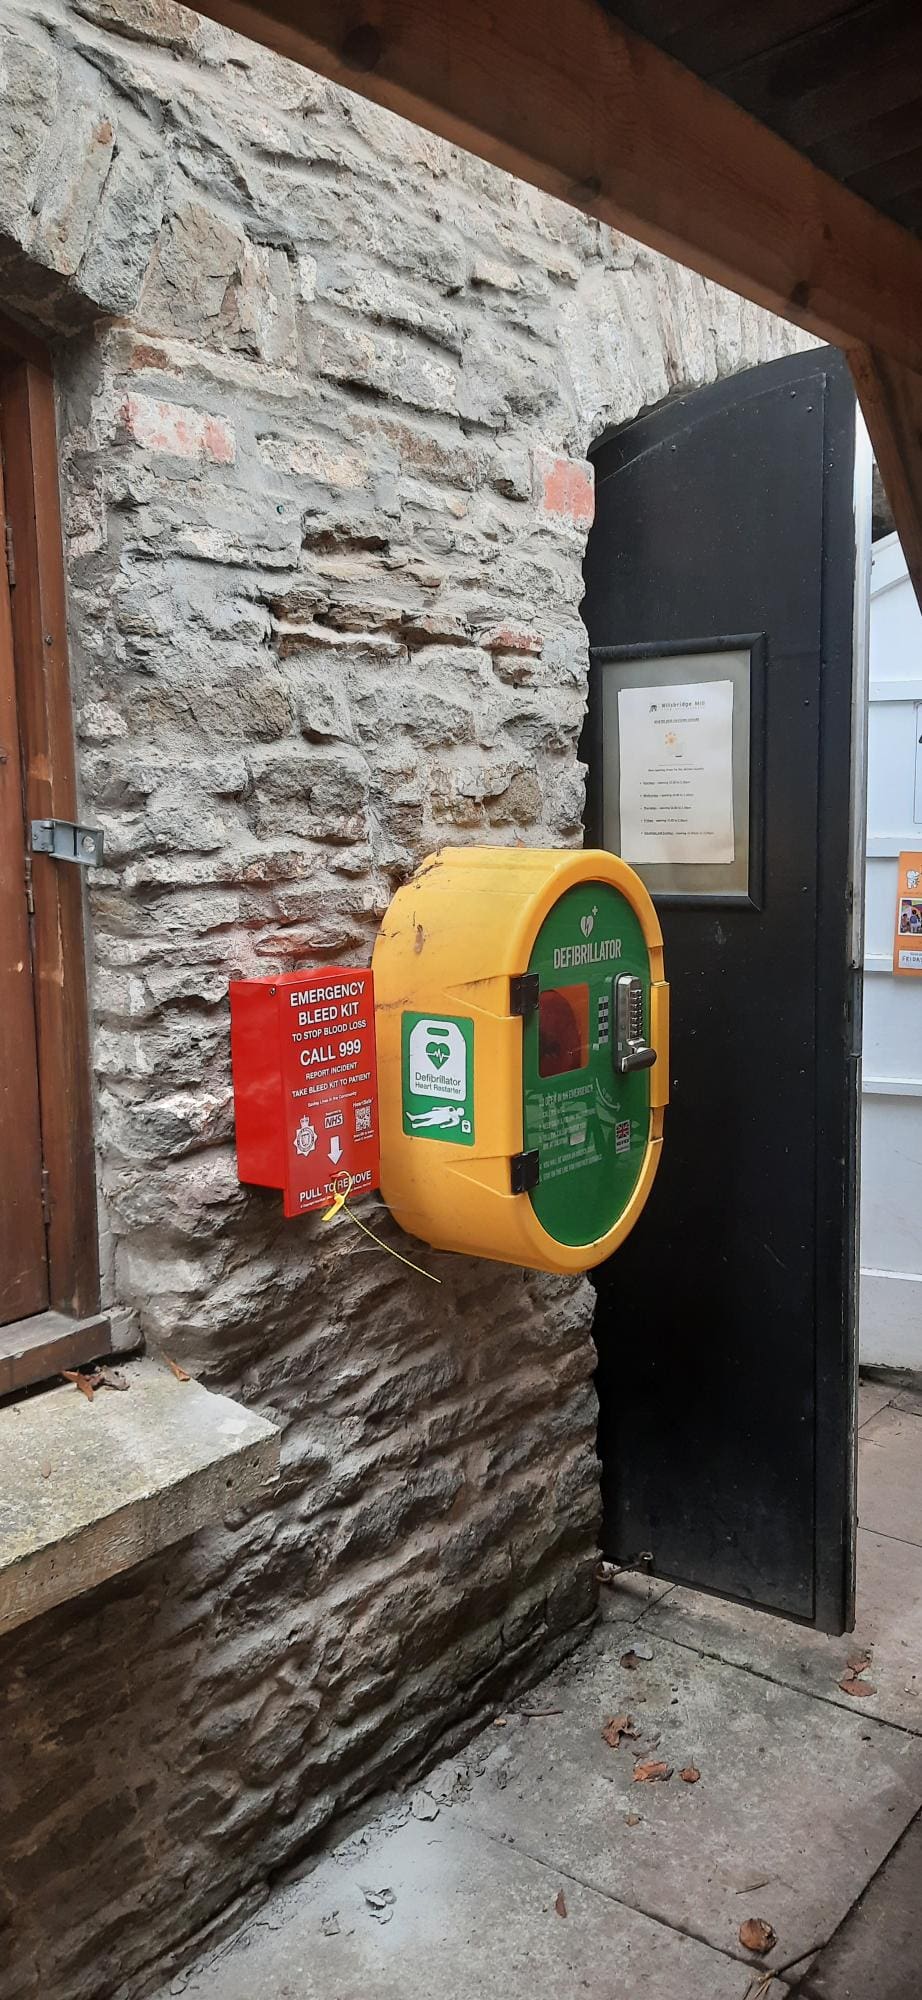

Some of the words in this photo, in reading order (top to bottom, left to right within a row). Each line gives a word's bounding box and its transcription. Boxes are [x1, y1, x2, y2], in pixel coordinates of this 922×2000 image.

[553, 938, 622, 969] DEFIBRILLATOR
[290, 981, 365, 1007] EMERGENCY
[298, 1006, 338, 1026] BLEED
[341, 1002, 359, 1017] KIT
[292, 1033, 302, 1042] TO
[303, 1029, 322, 1040] STOP
[323, 1023, 348, 1036] BLOOD
[349, 1019, 367, 1030] LOSS
[300, 1045, 336, 1066] CALL
[339, 1039, 361, 1057] 999
[305, 1068, 330, 1080] REPORT
[330, 1062, 358, 1074] INCIDENT
[415, 1072, 461, 1086] Defibrillator
[292, 1088, 309, 1098] TAKE
[308, 1083, 328, 1094] BLEED
[329, 1080, 339, 1089] KIT
[340, 1077, 348, 1086] TO
[348, 1072, 371, 1084] PATIENT
[415, 1083, 432, 1091] Heart
[433, 1085, 461, 1095] Restarter
[326, 1114, 342, 1127] NHS
[300, 1187, 322, 1202] PULL
[324, 1182, 336, 1194] TO
